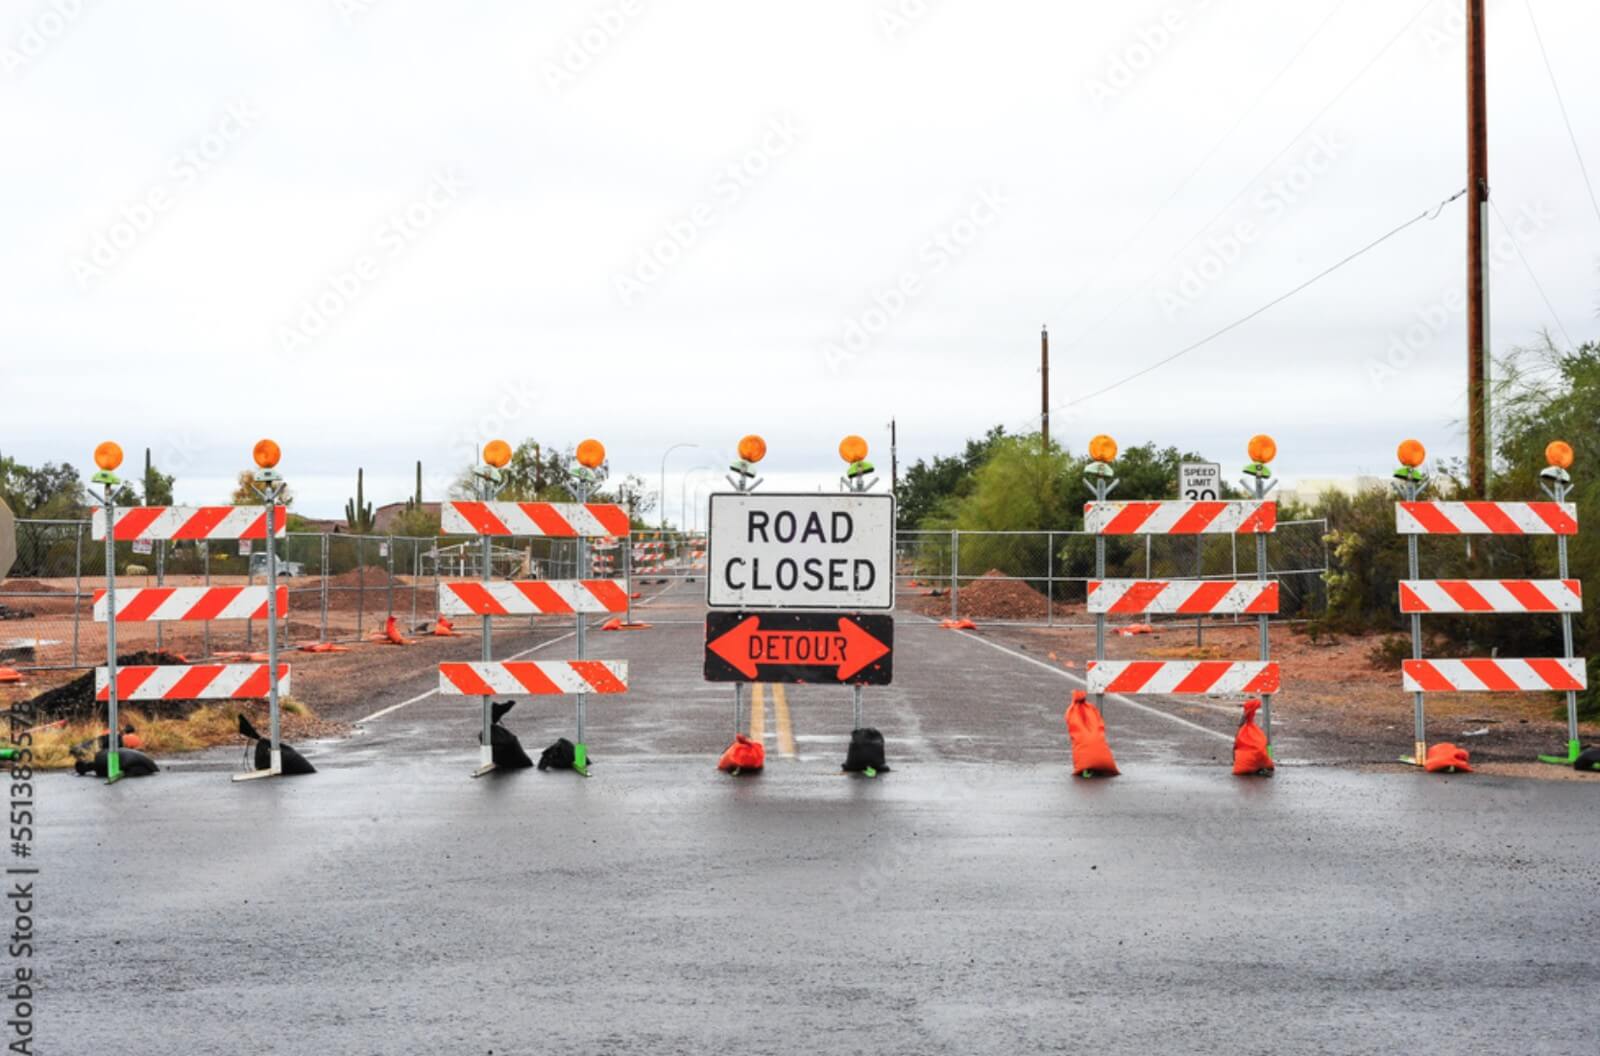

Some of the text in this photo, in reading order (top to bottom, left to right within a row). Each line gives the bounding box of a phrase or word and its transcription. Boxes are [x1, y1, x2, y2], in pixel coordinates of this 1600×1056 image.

[1183, 467, 1216, 477] SPEED
[1187, 478, 1212, 487] LIMIT
[747, 510, 853, 544] ROAD
[724, 557, 876, 592] CLOSED
[748, 634, 848, 662] DETOUR
